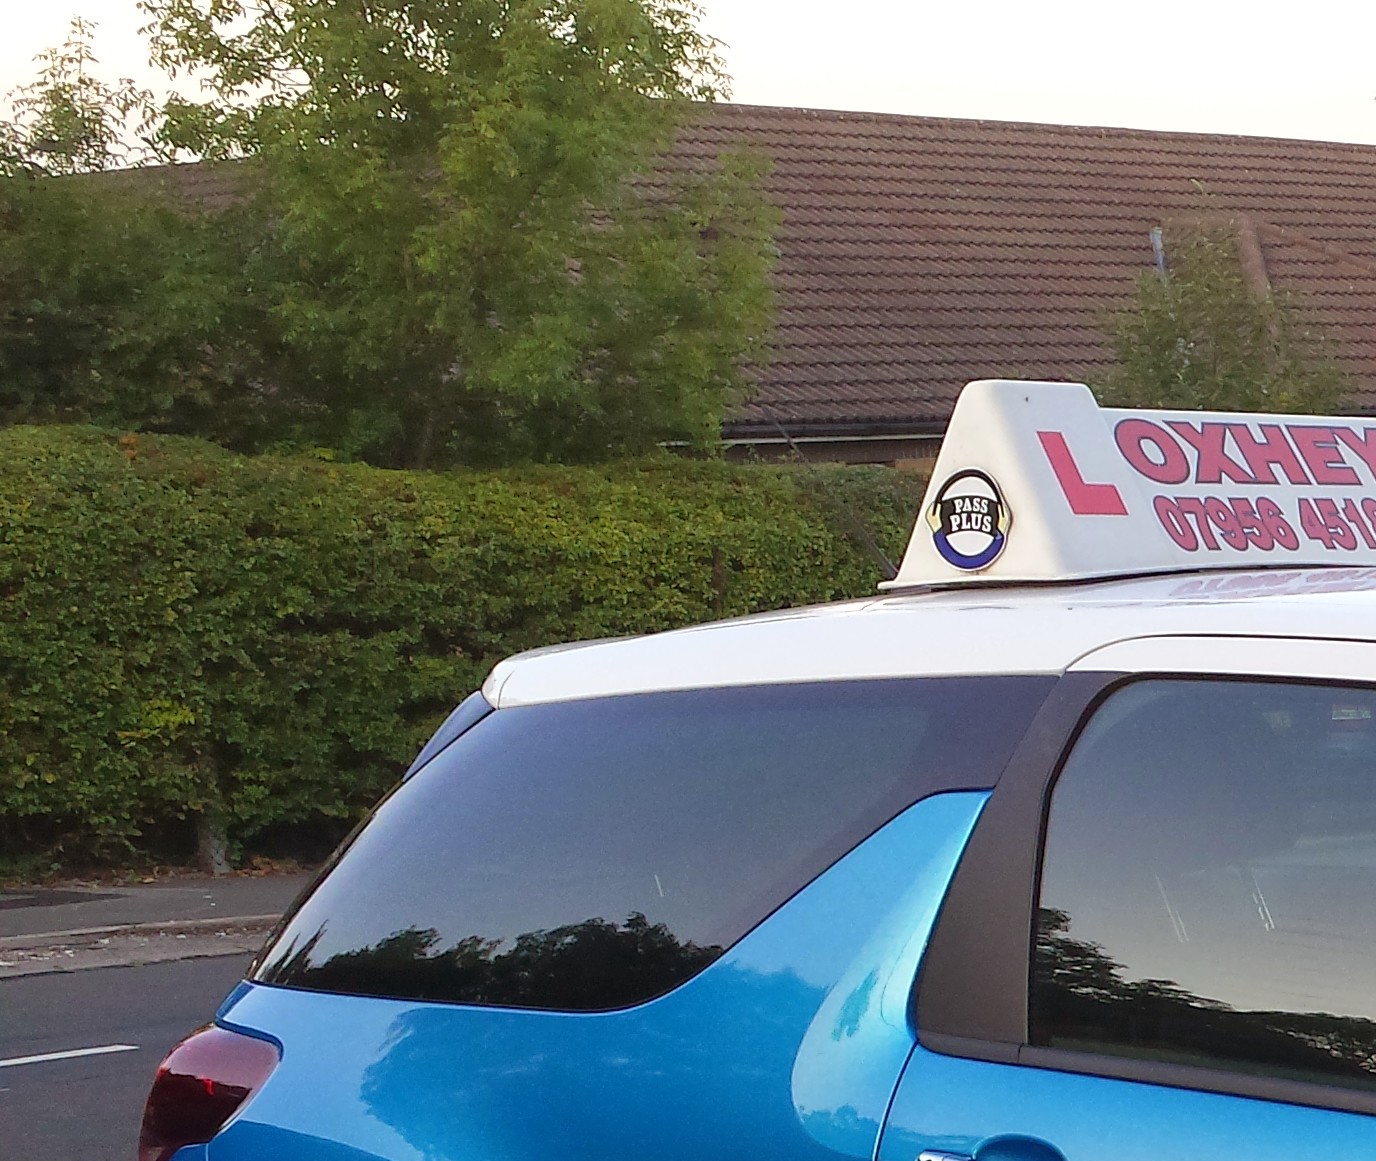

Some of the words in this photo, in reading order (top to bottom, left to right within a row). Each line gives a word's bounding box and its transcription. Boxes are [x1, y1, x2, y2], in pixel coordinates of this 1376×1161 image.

[1037, 431, 1128, 516] L
[950, 513, 992, 532] PLUS
[954, 498, 988, 513] PASS
[1152, 495, 1300, 551] 07956
